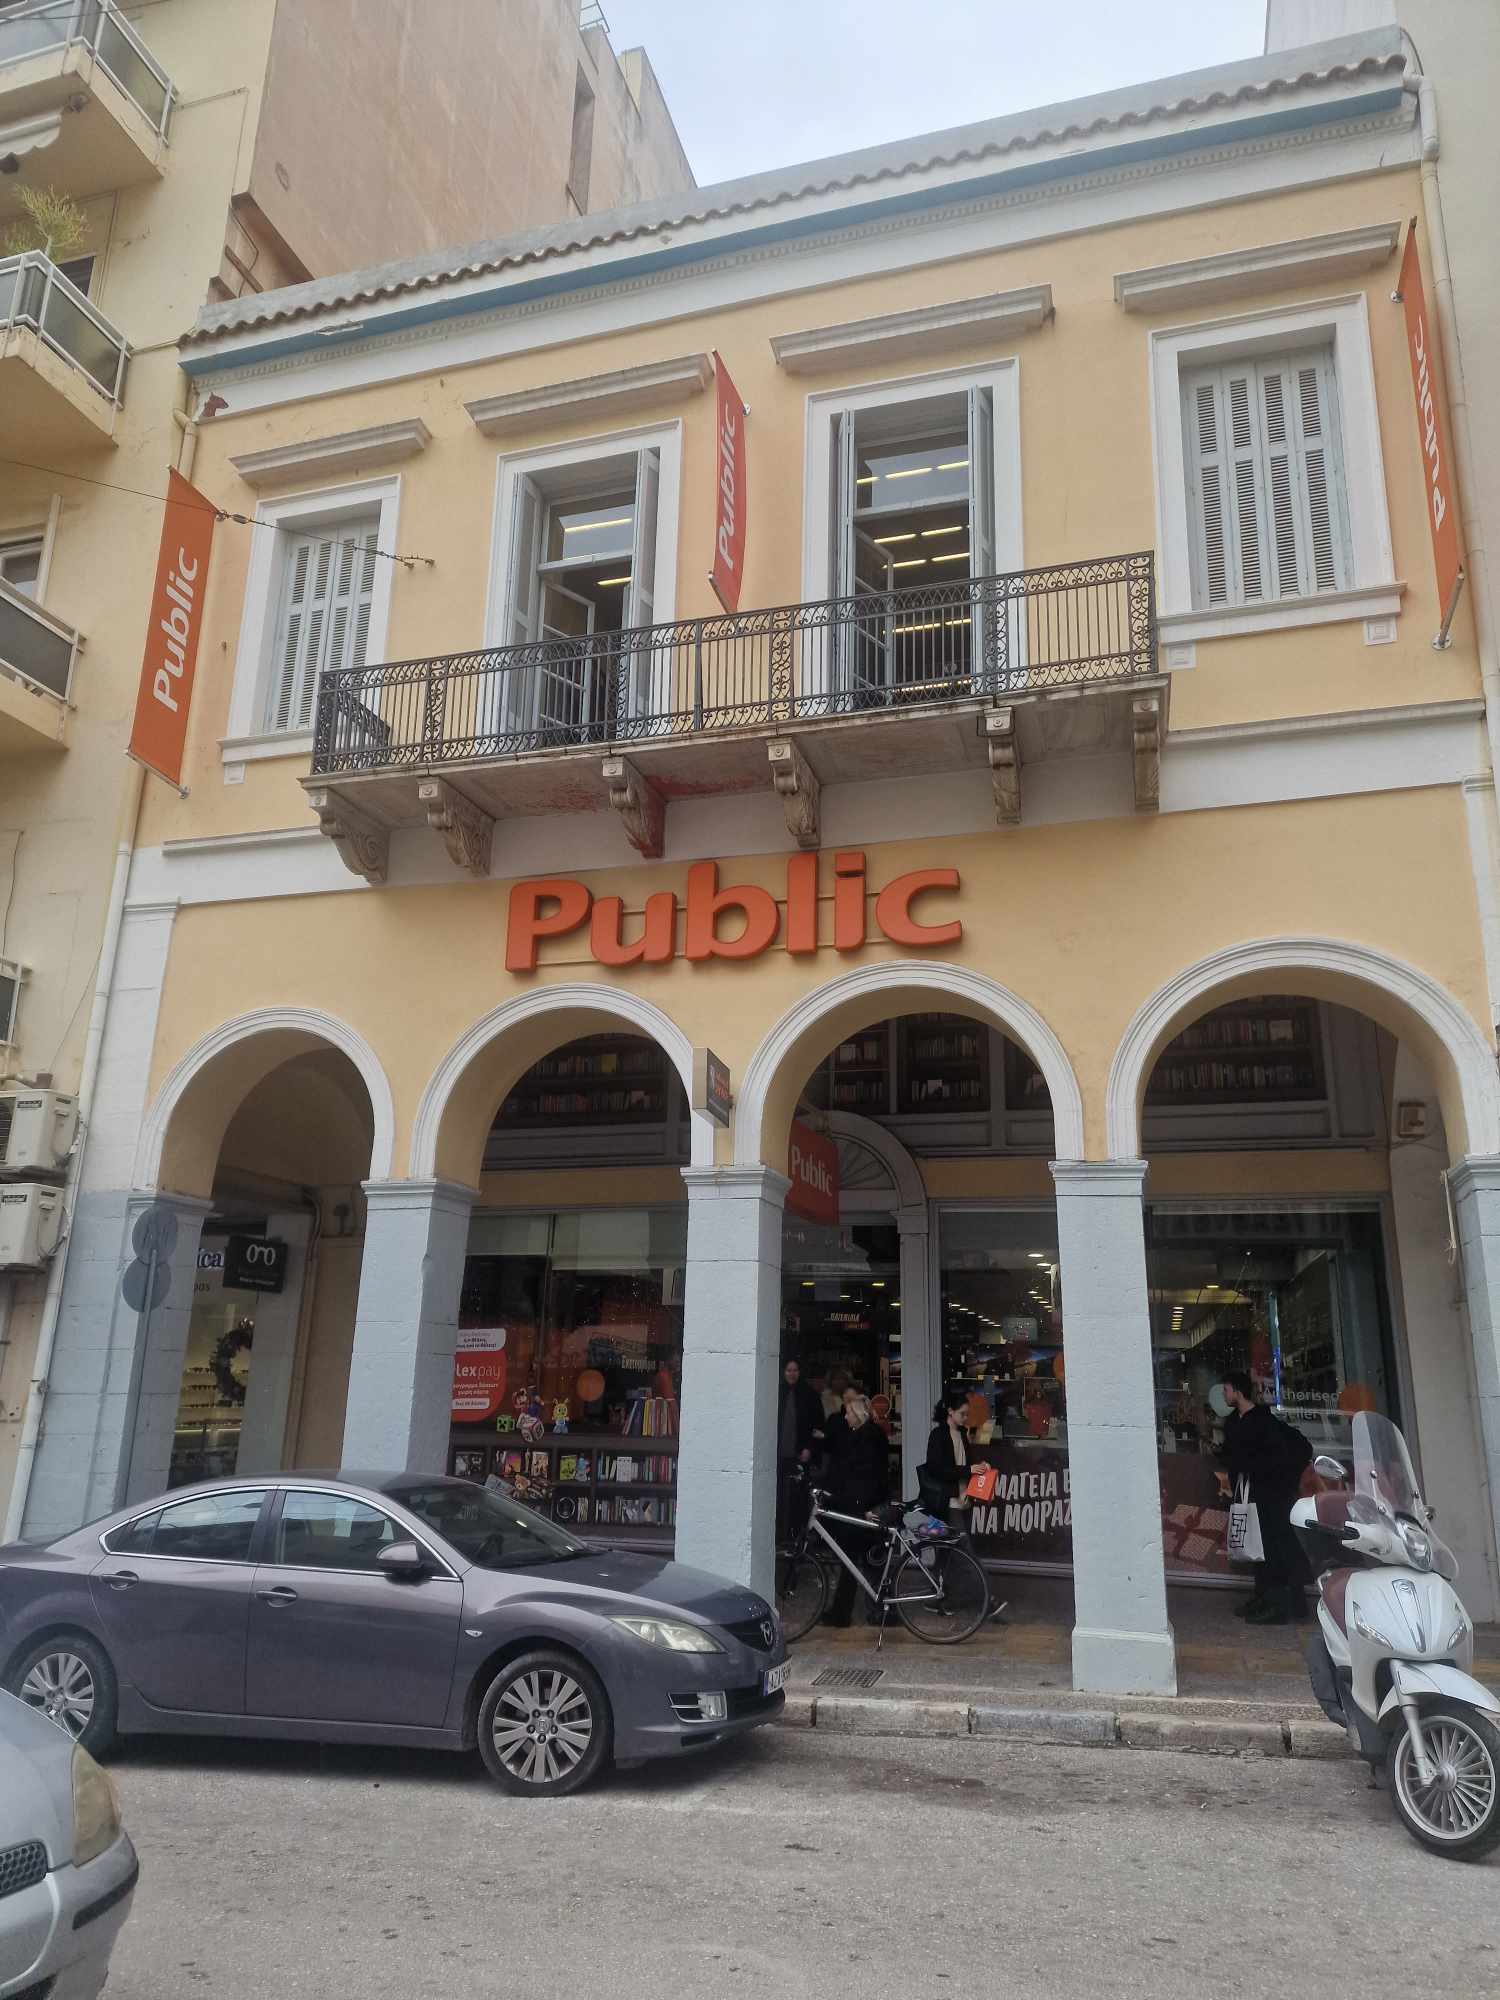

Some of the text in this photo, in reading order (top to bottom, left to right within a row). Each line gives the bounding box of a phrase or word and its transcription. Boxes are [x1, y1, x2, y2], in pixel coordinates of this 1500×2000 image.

[719, 403, 736, 572] Public
[1414, 315, 1446, 532] Public
[153, 547, 198, 713] Public
[505, 851, 963, 973] Public
[791, 1143, 833, 1197] Public
[971, 1506, 998, 1535] ΝΑ
